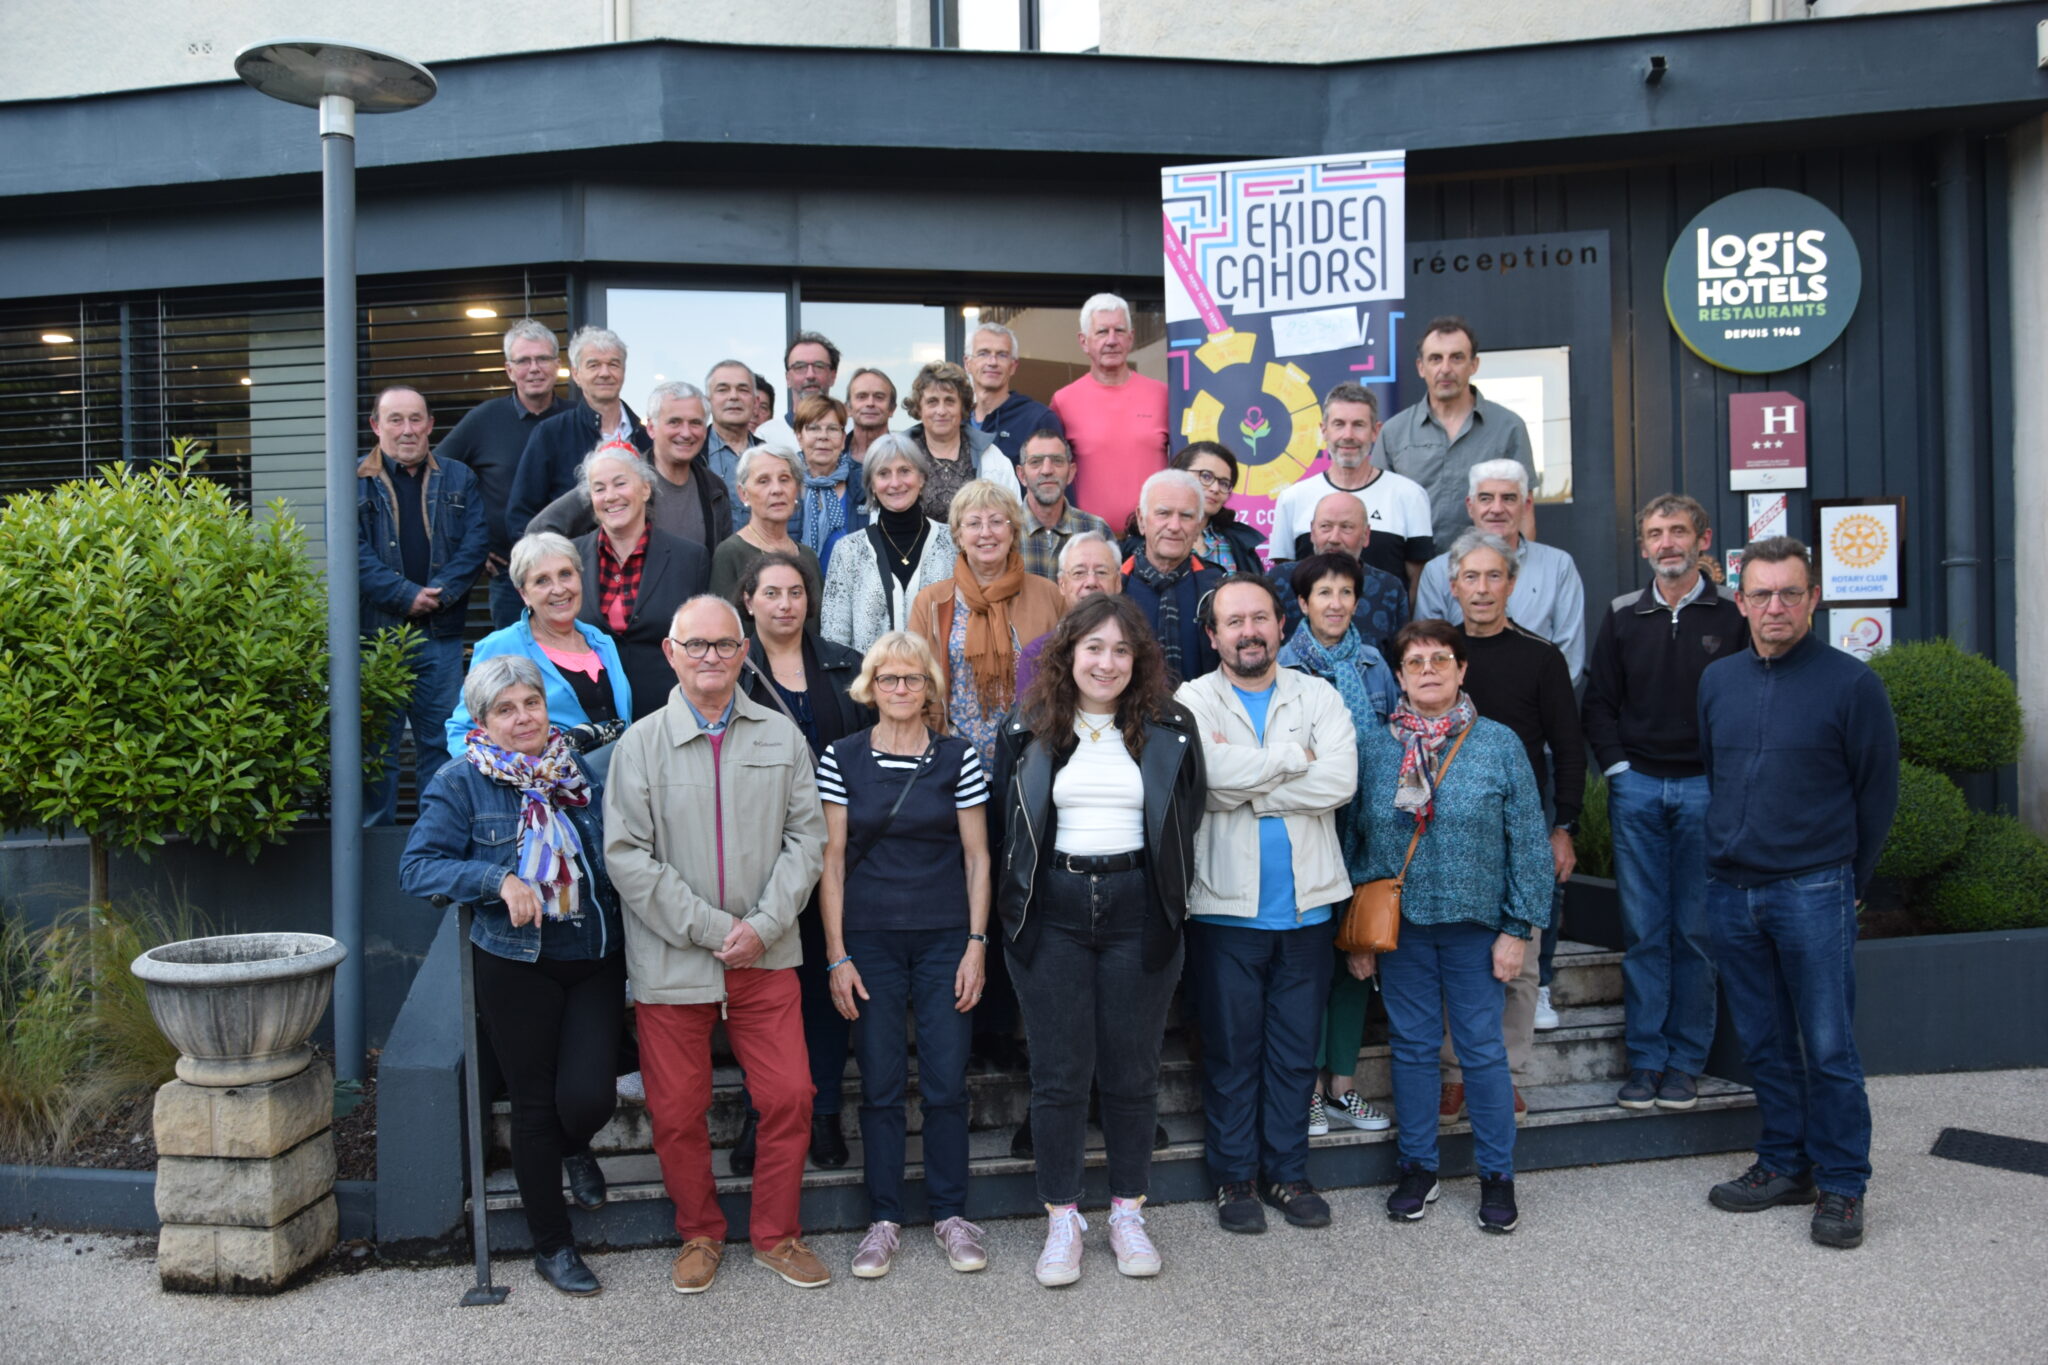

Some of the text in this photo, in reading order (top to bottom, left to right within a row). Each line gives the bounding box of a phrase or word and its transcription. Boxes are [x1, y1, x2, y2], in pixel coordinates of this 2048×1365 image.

[1247, 195, 1387, 291] EKIDEN
[1413, 244, 1597, 276] réception
[1217, 246, 1377, 308] CAHORS
[1698, 275, 1828, 306] HOTELS
[1699, 303, 1827, 322] RESTAURANTS
[1724, 326, 1801, 340] DEPUIS 1948
[1761, 405, 1798, 435] H
[1831, 574, 1888, 583] ROTARY CLUB
[1836, 585, 1884, 593] DE CAHORS
